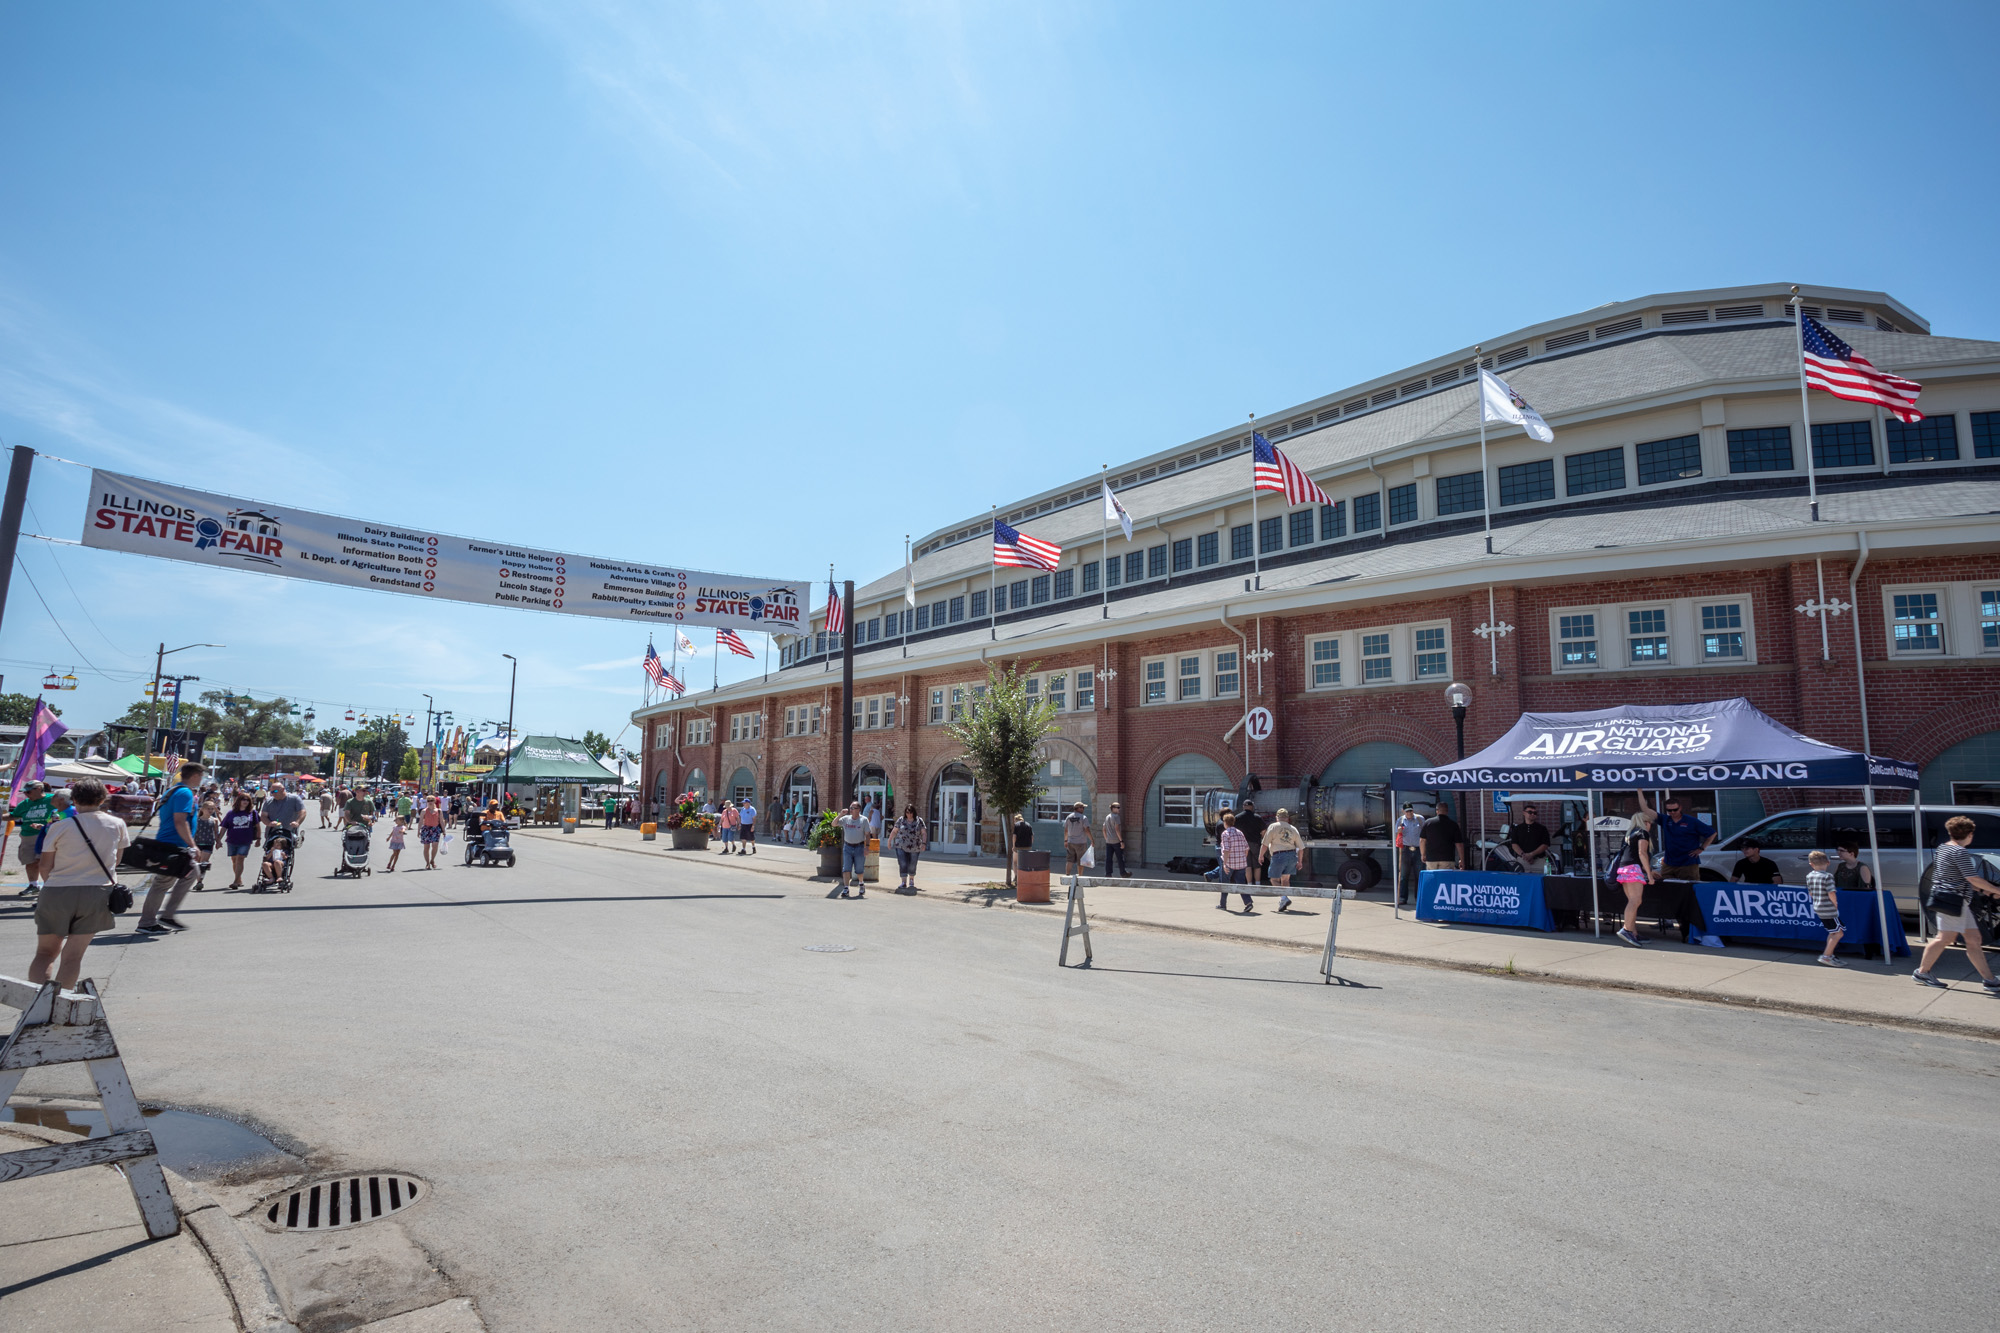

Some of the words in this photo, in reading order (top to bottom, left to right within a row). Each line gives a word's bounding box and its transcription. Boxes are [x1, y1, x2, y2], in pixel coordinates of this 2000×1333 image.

[102, 493, 196, 522] ILLINOIS
[94, 508, 196, 543] STATE
[219, 530, 283, 558] FAIR
[364, 526, 388, 537] Dairy
[390, 531, 425, 544] Building
[337, 532, 369, 544] Illinois
[370, 537, 396, 548] State
[397, 543, 425, 553] Police
[342, 546, 396, 561] Information
[397, 553, 424, 564] Booth
[468, 544, 504, 556] Farmer's
[505, 549, 526, 559] Little
[527, 553, 554, 563] Helper
[300, 551, 310, 560] IL
[311, 553, 338, 565] Dept.
[339, 558, 351, 566] of
[351, 560, 402, 575] Agriculture
[403, 567, 423, 577] Tent
[501, 559, 527, 569] Happy
[528, 563, 554, 572] Hollow
[589, 561, 625, 573] Hobbies,
[626, 566, 643, 575] Arts
[651, 570, 676, 579] Crafts
[369, 574, 422, 589] Grandstand
[511, 570, 554, 583] Restrooms
[609, 573, 649, 585] Adventure
[650, 578, 676, 589] Village
[499, 580, 528, 591] Lincoln
[529, 584, 552, 595] Stage
[603, 582, 644, 595] Emmerson
[645, 588, 675, 600] Building
[697, 586, 751, 602] ILLINOIS
[495, 592, 520, 602] Public
[521, 595, 551, 607] Parking
[591, 592, 647, 607] Rabbit/Poultry
[648, 599, 675, 609] Exhibit
[629, 608, 673, 619] Floriculture
[694, 597, 750, 617] STATE
[763, 603, 800, 622] FAIR
[1248, 711, 1268, 736] 12
[1594, 718, 1644, 729] ILLINOIS
[1607, 723, 1714, 738] NATIONAL
[466, 738, 475, 764] ATM
[1518, 729, 1606, 756] AIR
[1601, 733, 1712, 752] GUARD
[1513, 751, 1594, 761] GoANG.com/IL
[1604, 747, 1705, 756] 800-TO-GO-ANG
[1422, 768, 1571, 785] GoANG.com/IL
[1591, 762, 1809, 784] 800-TO-GO-ANG
[1433, 883, 1473, 906] AIR
[1473, 884, 1520, 896] NATIONAL
[1766, 890, 1813, 903] NATIO
[1472, 894, 1520, 909] GUARD
[1712, 890, 1768, 916] AIR
[1767, 901, 1818, 919] GUA
[1713, 916, 1763, 924] GoANG.com
[1770, 919, 1824, 927] 800-TO-GO-A
